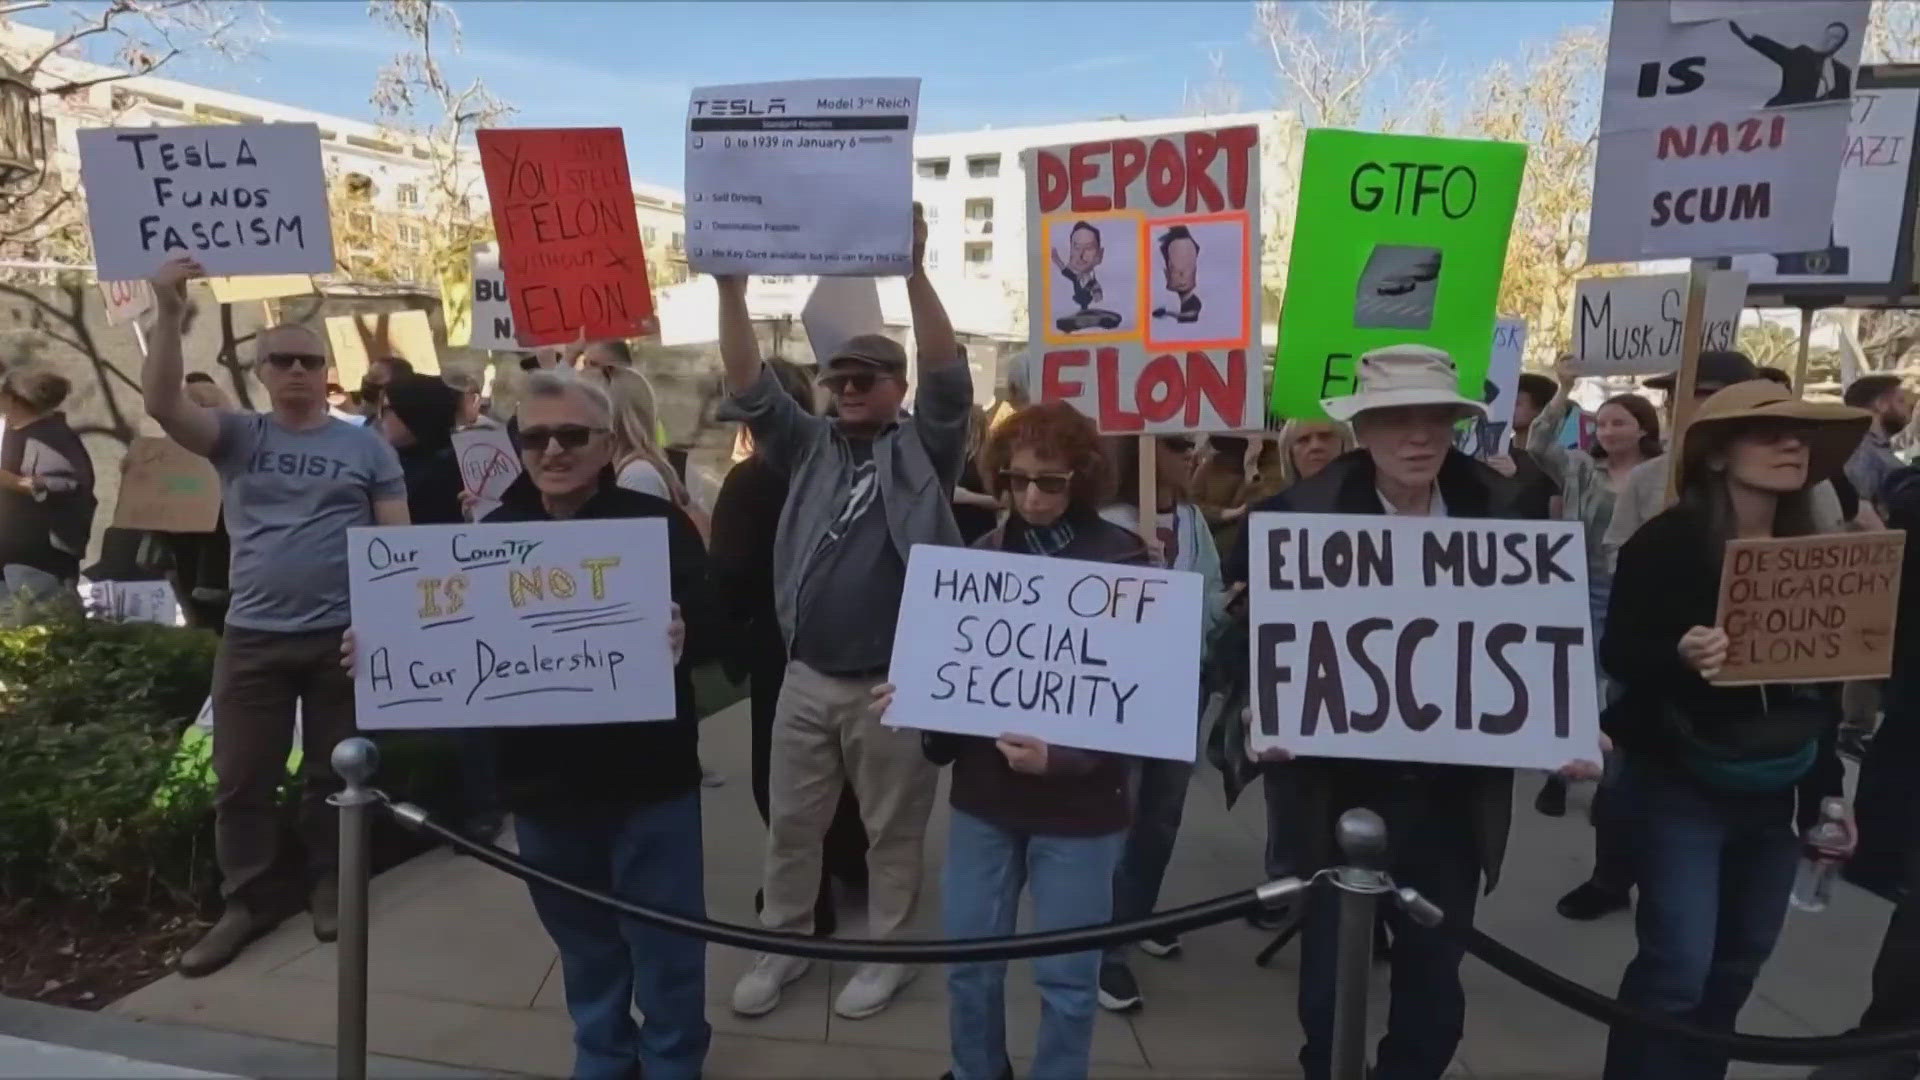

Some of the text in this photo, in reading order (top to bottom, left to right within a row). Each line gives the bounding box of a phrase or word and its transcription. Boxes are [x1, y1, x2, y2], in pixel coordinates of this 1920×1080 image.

[1637, 56, 1706, 98] IS
[694, 98, 787, 116] TESLA
[816, 99, 853, 110] Model
[877, 98, 911, 109] Reich
[116, 133, 257, 171] TESLA
[738, 136, 749, 148] to
[752, 136, 778, 148] 1939
[782, 136, 793, 148] in
[797, 136, 845, 150] January
[1657, 115, 1786, 160] NAZI
[153, 177, 270, 208] FUNDS
[492, 143, 560, 200] YOU
[1037, 124, 1258, 214] DEPORT
[1350, 162, 1477, 220] GTFO
[504, 198, 624, 245] FELON
[1650, 182, 1771, 227] SCUM
[139, 214, 304, 251] FASCISM
[475, 279, 507, 302] BU
[521, 282, 629, 335] ELON
[1660, 288, 1739, 356] STKS!
[1041, 346, 1247, 432] ELON
[368, 538, 418, 571] Our
[1267, 528, 1576, 590] ELON MUSK
[417, 557, 621, 619] IS NOT
[934, 569, 1169, 624] HANDS OFF
[1728, 572, 1894, 604] OLIGARCHY
[953, 615, 1108, 667] SOCIAL
[1723, 605, 1846, 638] GROUND
[370, 639, 625, 706] A Car Dealership
[930, 661, 1140, 725] SECURITY
[1257, 617, 1585, 738] FASCIST
